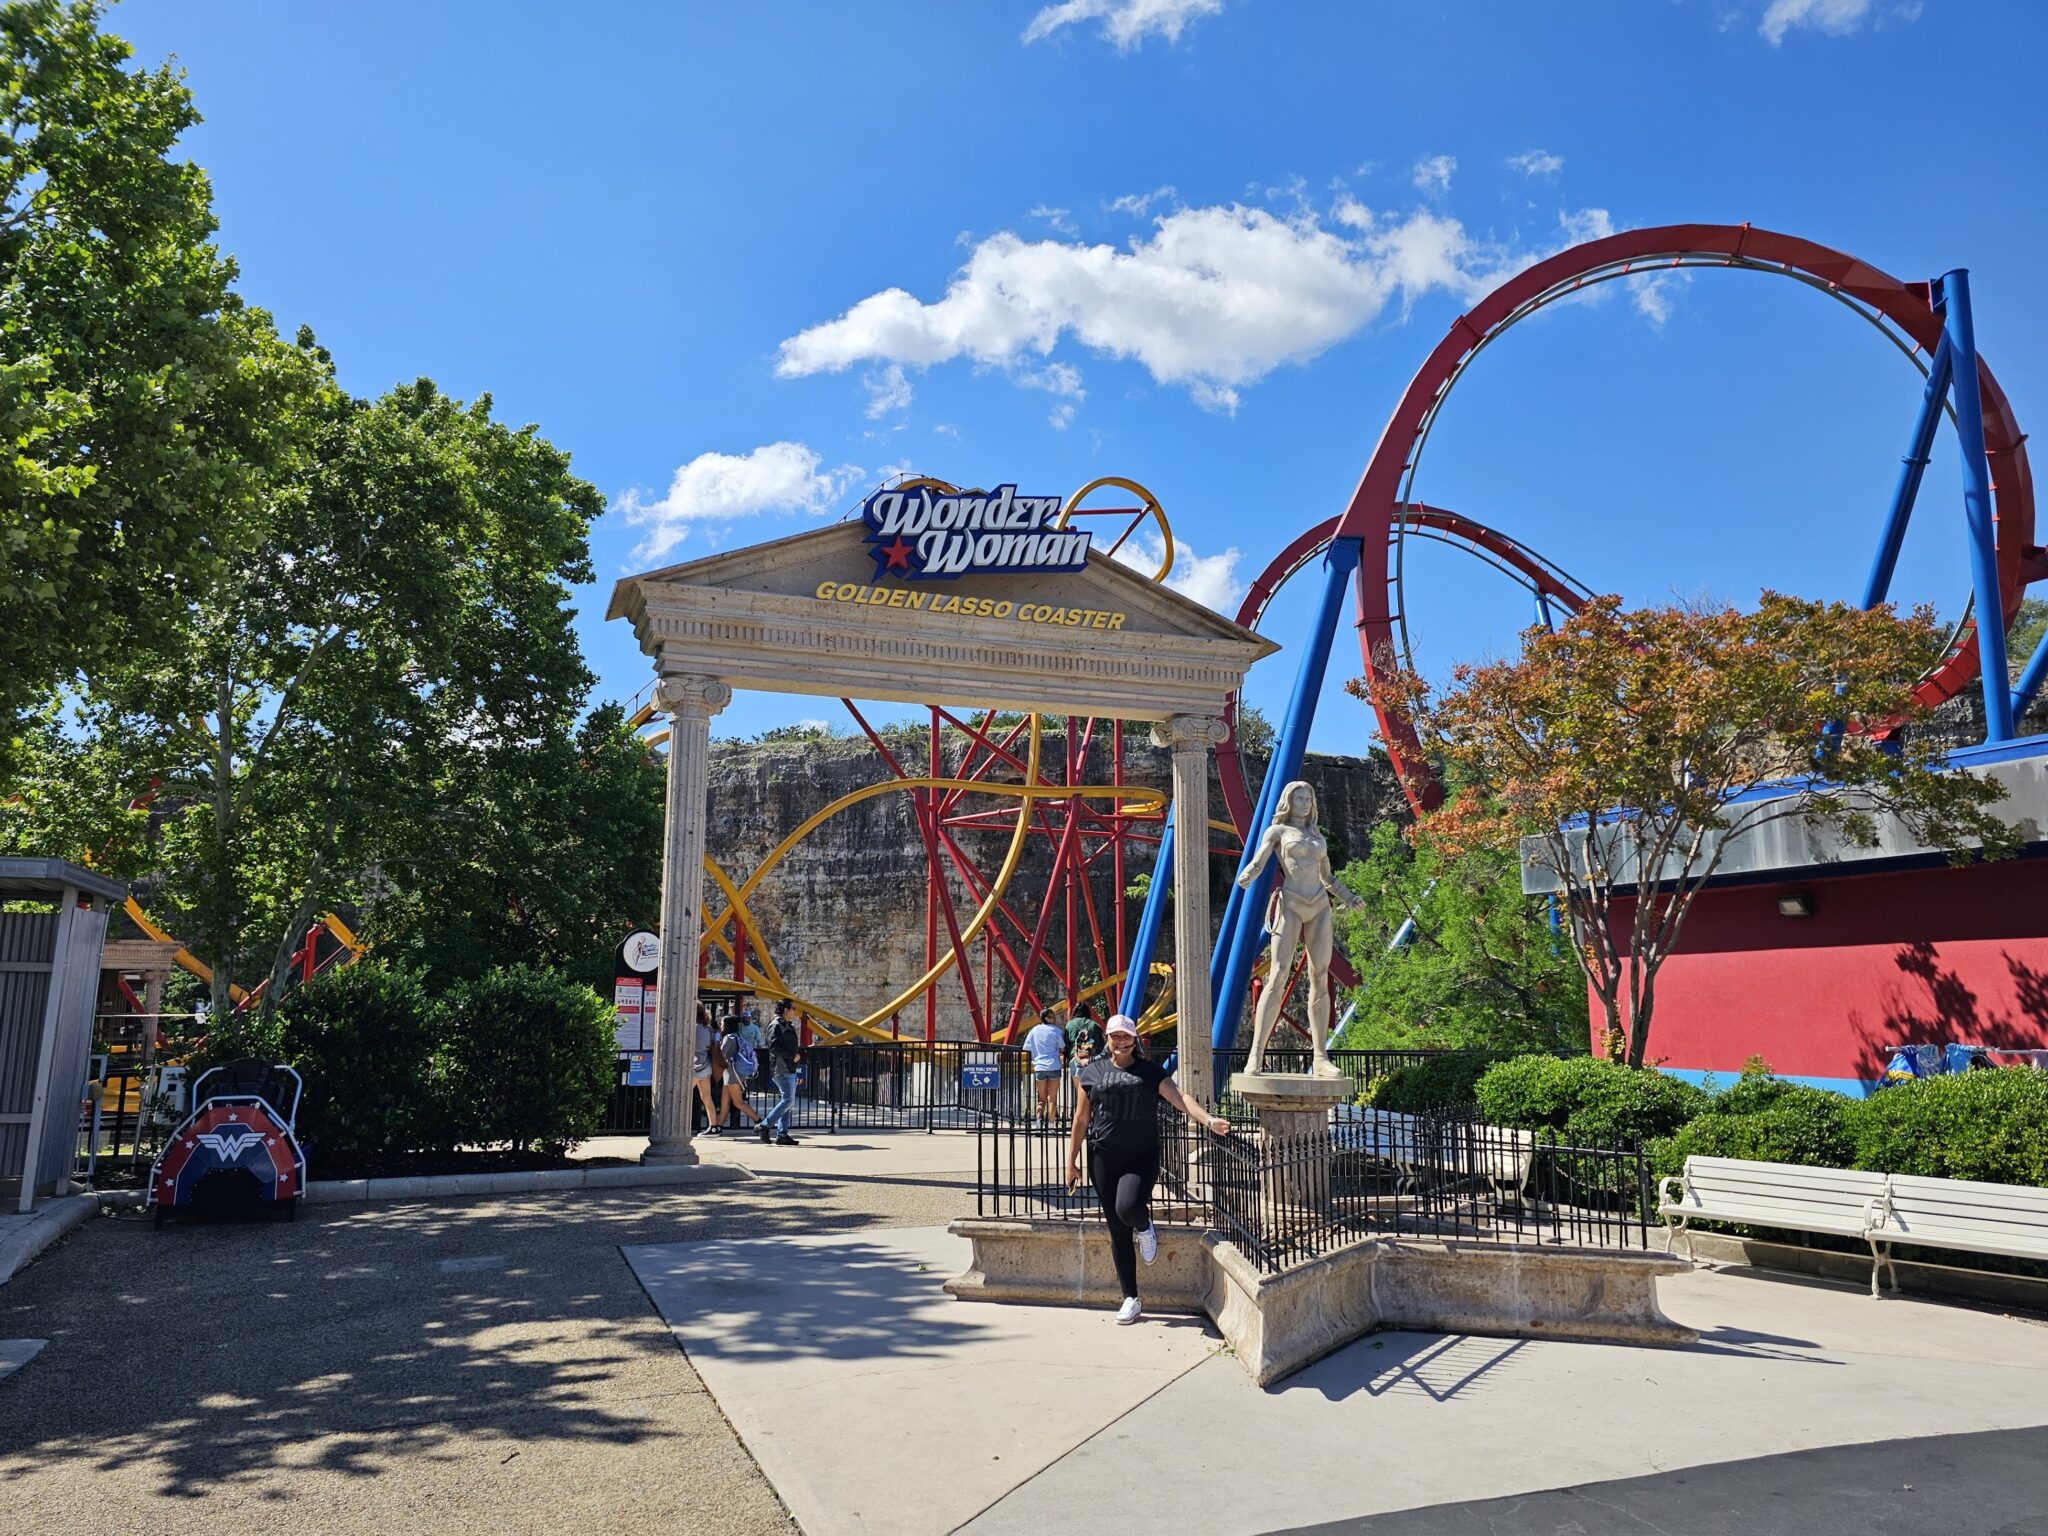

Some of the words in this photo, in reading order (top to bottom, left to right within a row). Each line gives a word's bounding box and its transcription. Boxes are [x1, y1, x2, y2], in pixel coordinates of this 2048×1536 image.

[872, 486, 1060, 536] Wonder
[916, 528, 1091, 573] Woman
[815, 581, 927, 610] GOLDEN
[928, 593, 1013, 619] LASSO
[1017, 603, 1127, 630] COASTER
